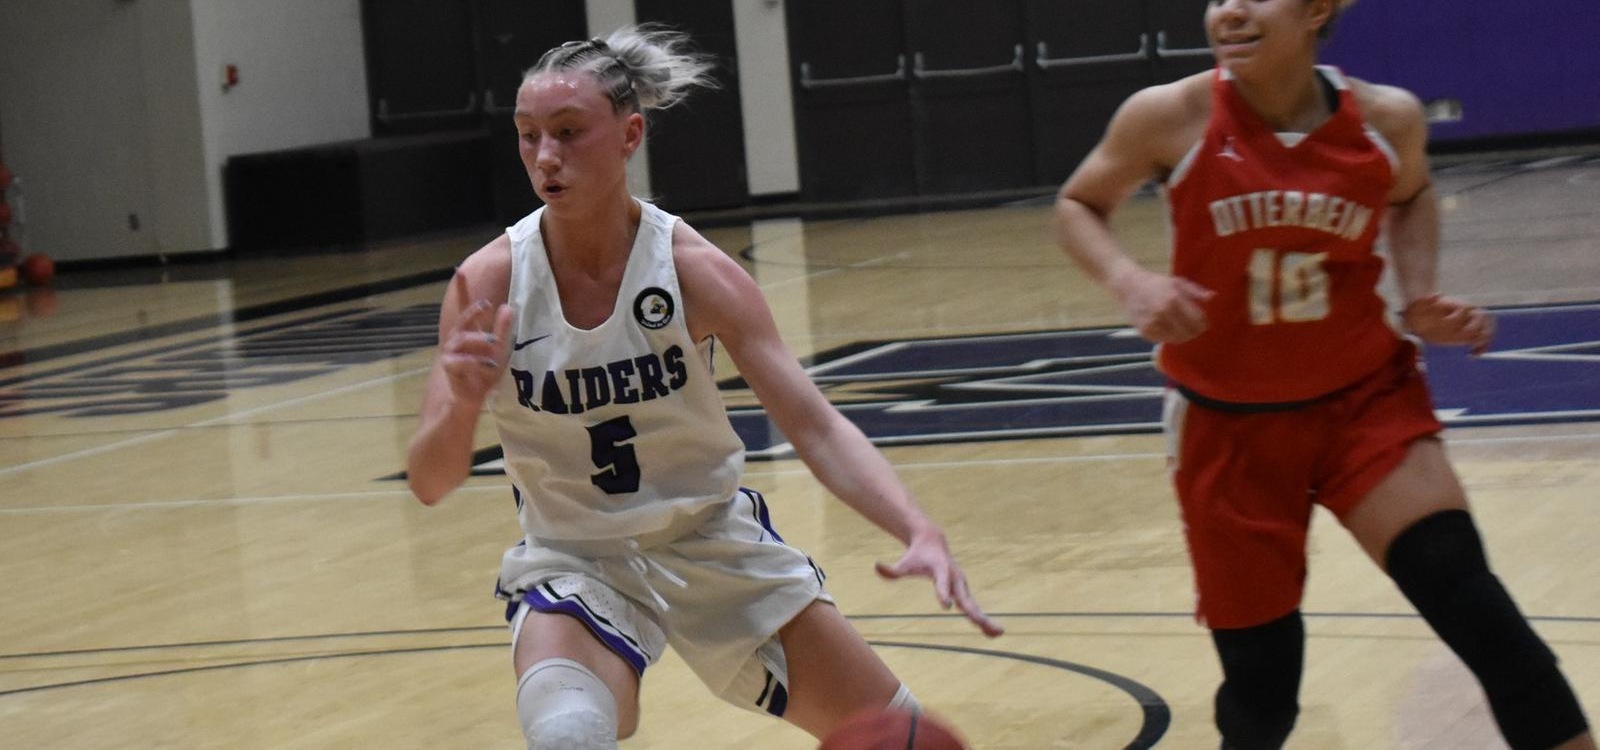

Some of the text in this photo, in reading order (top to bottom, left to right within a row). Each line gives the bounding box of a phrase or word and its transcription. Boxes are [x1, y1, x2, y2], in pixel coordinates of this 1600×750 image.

[1209, 190, 1374, 241] OTTERBEIN
[511, 344, 688, 414] RAIDERS
[584, 415, 641, 495] 5
